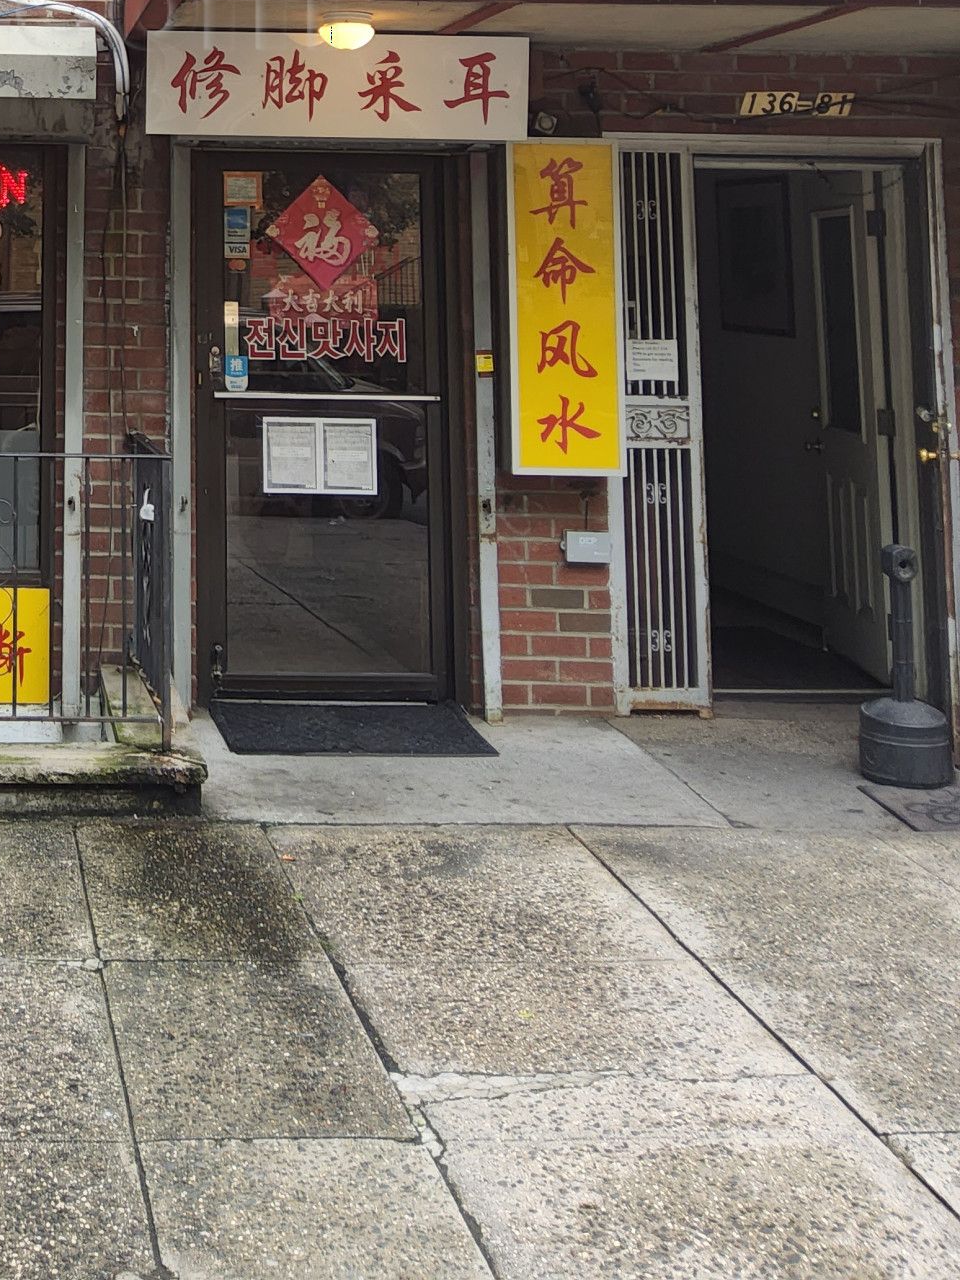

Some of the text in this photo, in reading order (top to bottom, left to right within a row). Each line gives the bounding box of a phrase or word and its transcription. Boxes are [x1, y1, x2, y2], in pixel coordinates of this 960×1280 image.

[170, 45, 510, 126] 修脚采耳
[229, 245, 247, 254] VISA
[281, 288, 365, 313] 大吉大利
[529, 157, 602, 455] 算命风水
[244, 317, 407, 363] 전신맛사지
